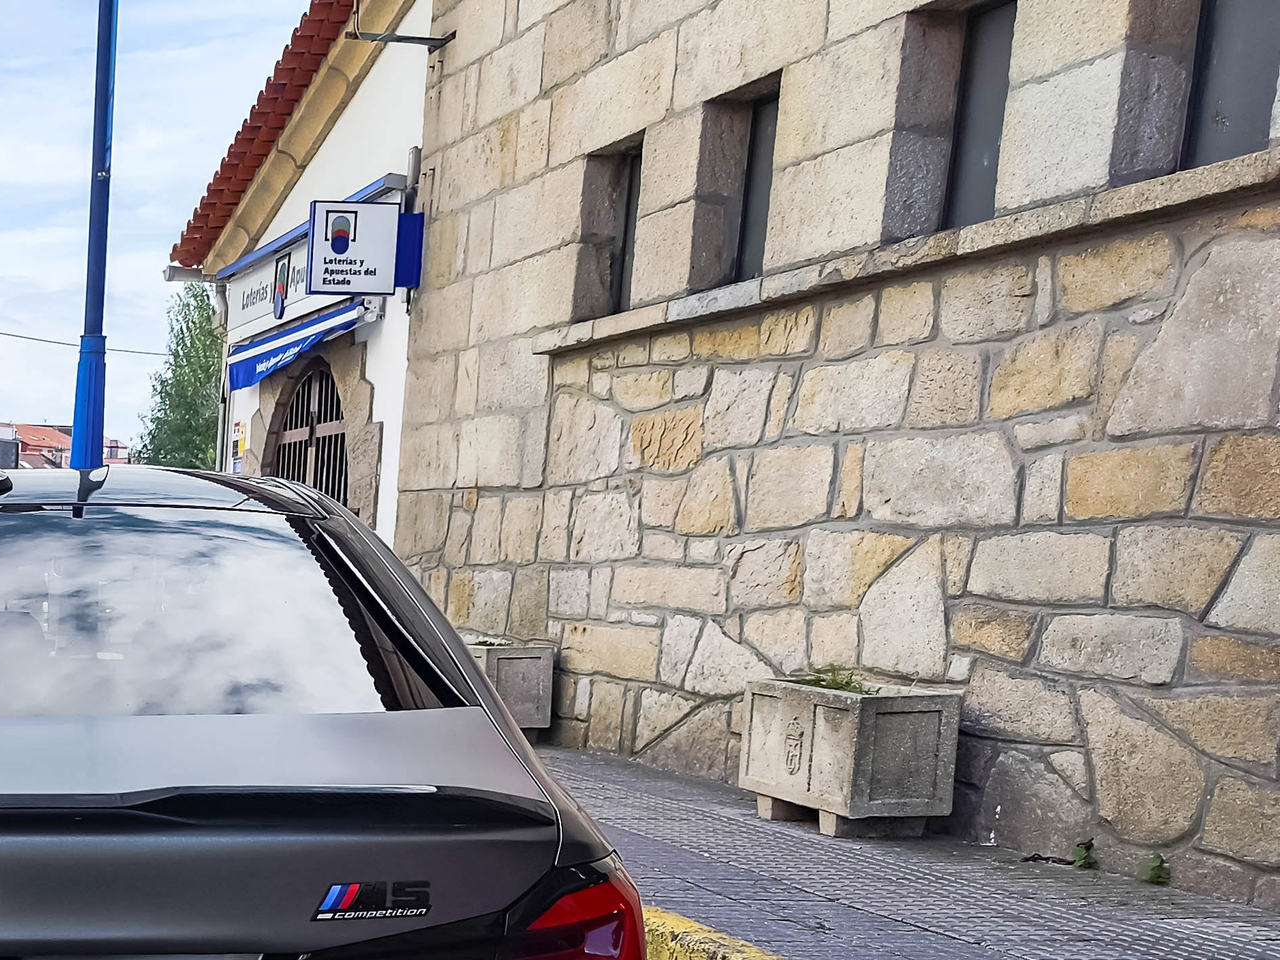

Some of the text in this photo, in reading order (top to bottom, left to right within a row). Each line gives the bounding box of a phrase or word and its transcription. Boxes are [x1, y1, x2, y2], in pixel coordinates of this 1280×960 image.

[323, 256, 365, 267] Loterías y
[323, 267, 377, 277] Apuestas del
[322, 277, 351, 286] Estado
[241, 279, 268, 310] Loterías
[354, 881, 431, 908] M5
[334, 908, 427, 919] competition
